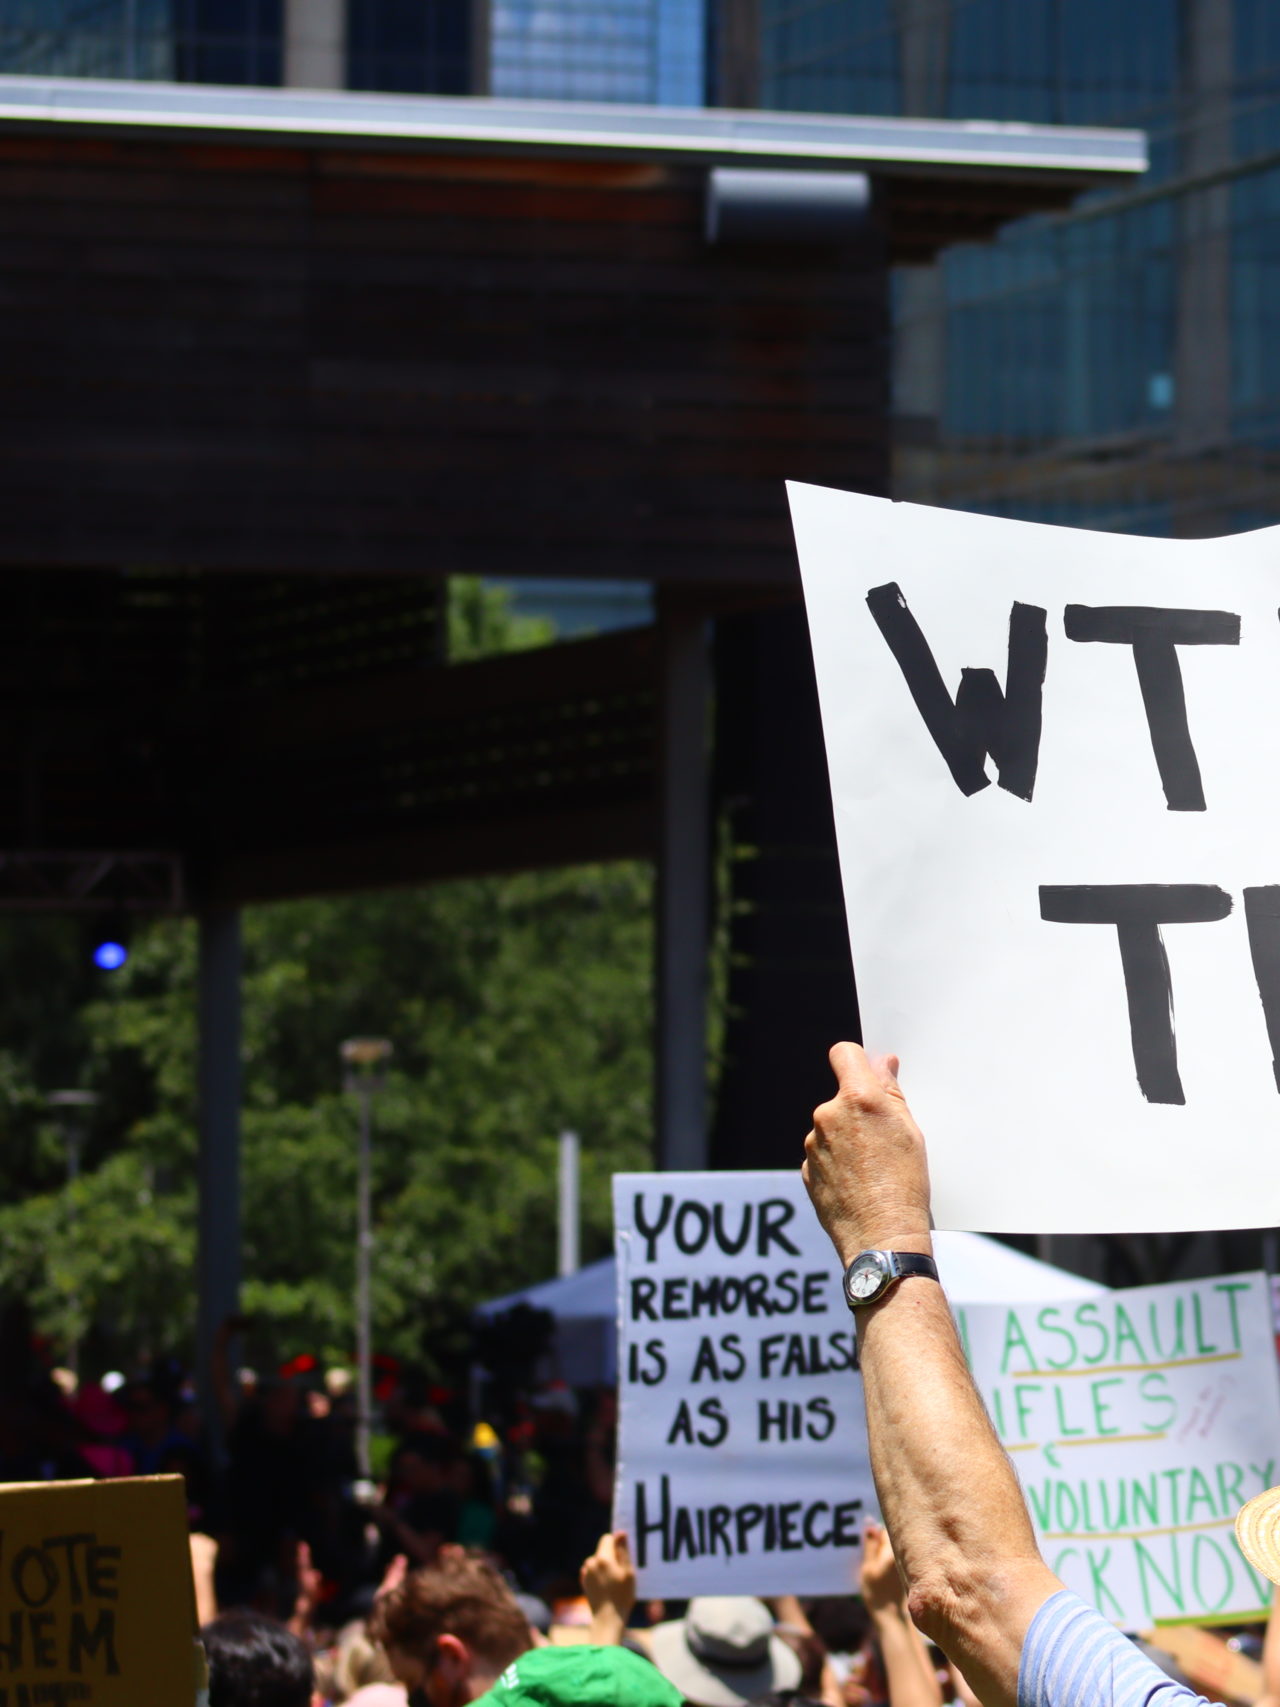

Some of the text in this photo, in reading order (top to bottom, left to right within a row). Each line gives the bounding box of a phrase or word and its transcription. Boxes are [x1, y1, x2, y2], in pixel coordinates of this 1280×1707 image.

[634, 1193, 802, 1262] YOUR
[631, 1271, 830, 1321] REMORSE
[1001, 1282, 1252, 1374] ASSAULT
[629, 1340, 668, 1385] IS
[690, 1334, 746, 1382] AS
[667, 1397, 835, 1447] AS HIS
[994, 1372, 1178, 1438] IFLES
[635, 1474, 862, 1568] HAIRPIECE
[1028, 1459, 1275, 1533] VOLUNTARY
[0, 1531, 122, 1608] OTE
[0, 1608, 121, 1676] HEM
